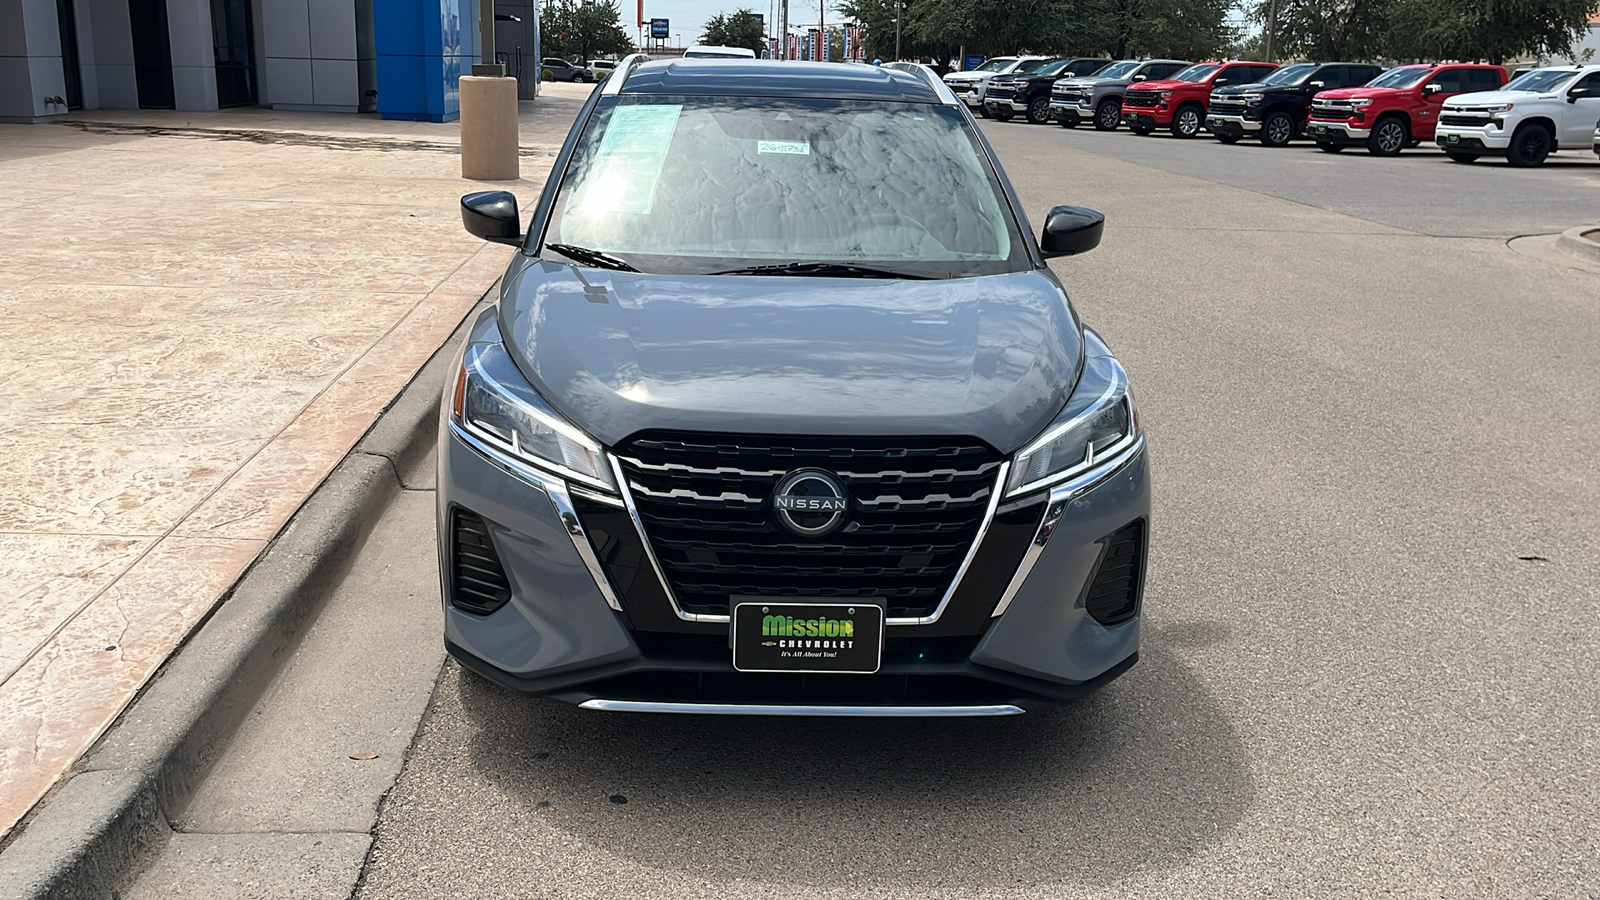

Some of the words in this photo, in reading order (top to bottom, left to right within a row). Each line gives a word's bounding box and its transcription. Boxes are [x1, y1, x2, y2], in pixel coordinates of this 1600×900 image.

[776, 497, 846, 510] NISSAN
[762, 614, 854, 637] Mission
[779, 639, 853, 649] CHEVROLET
[780, 650, 791, 658] It's
[792, 650, 802, 658] All
